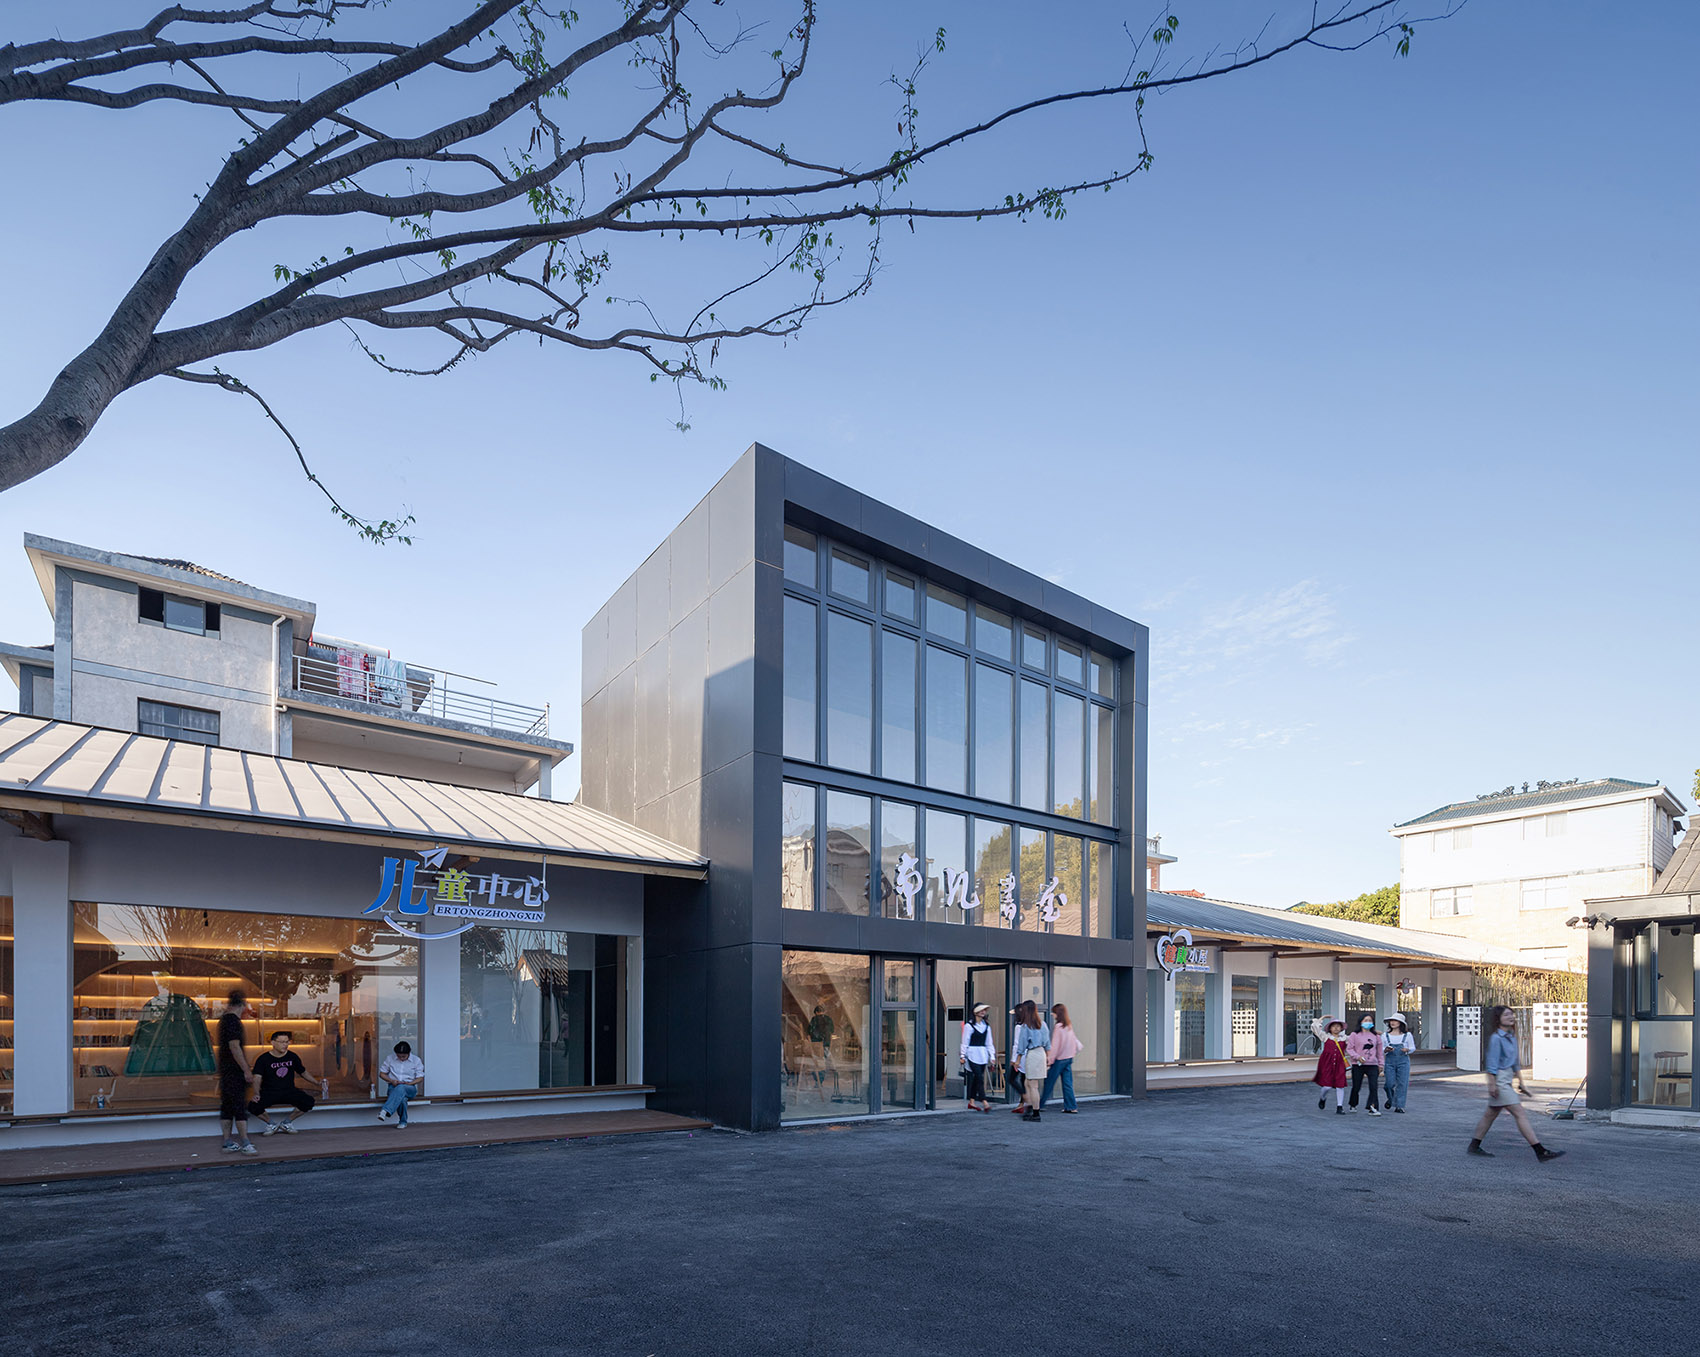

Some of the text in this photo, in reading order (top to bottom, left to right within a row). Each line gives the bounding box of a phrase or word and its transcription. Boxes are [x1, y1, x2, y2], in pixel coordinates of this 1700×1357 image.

[363, 856, 549, 915] 儿童中心
[436, 906, 544, 921] ERTONGZHONGXIN
[270, 1061, 293, 1069] GUCCI
